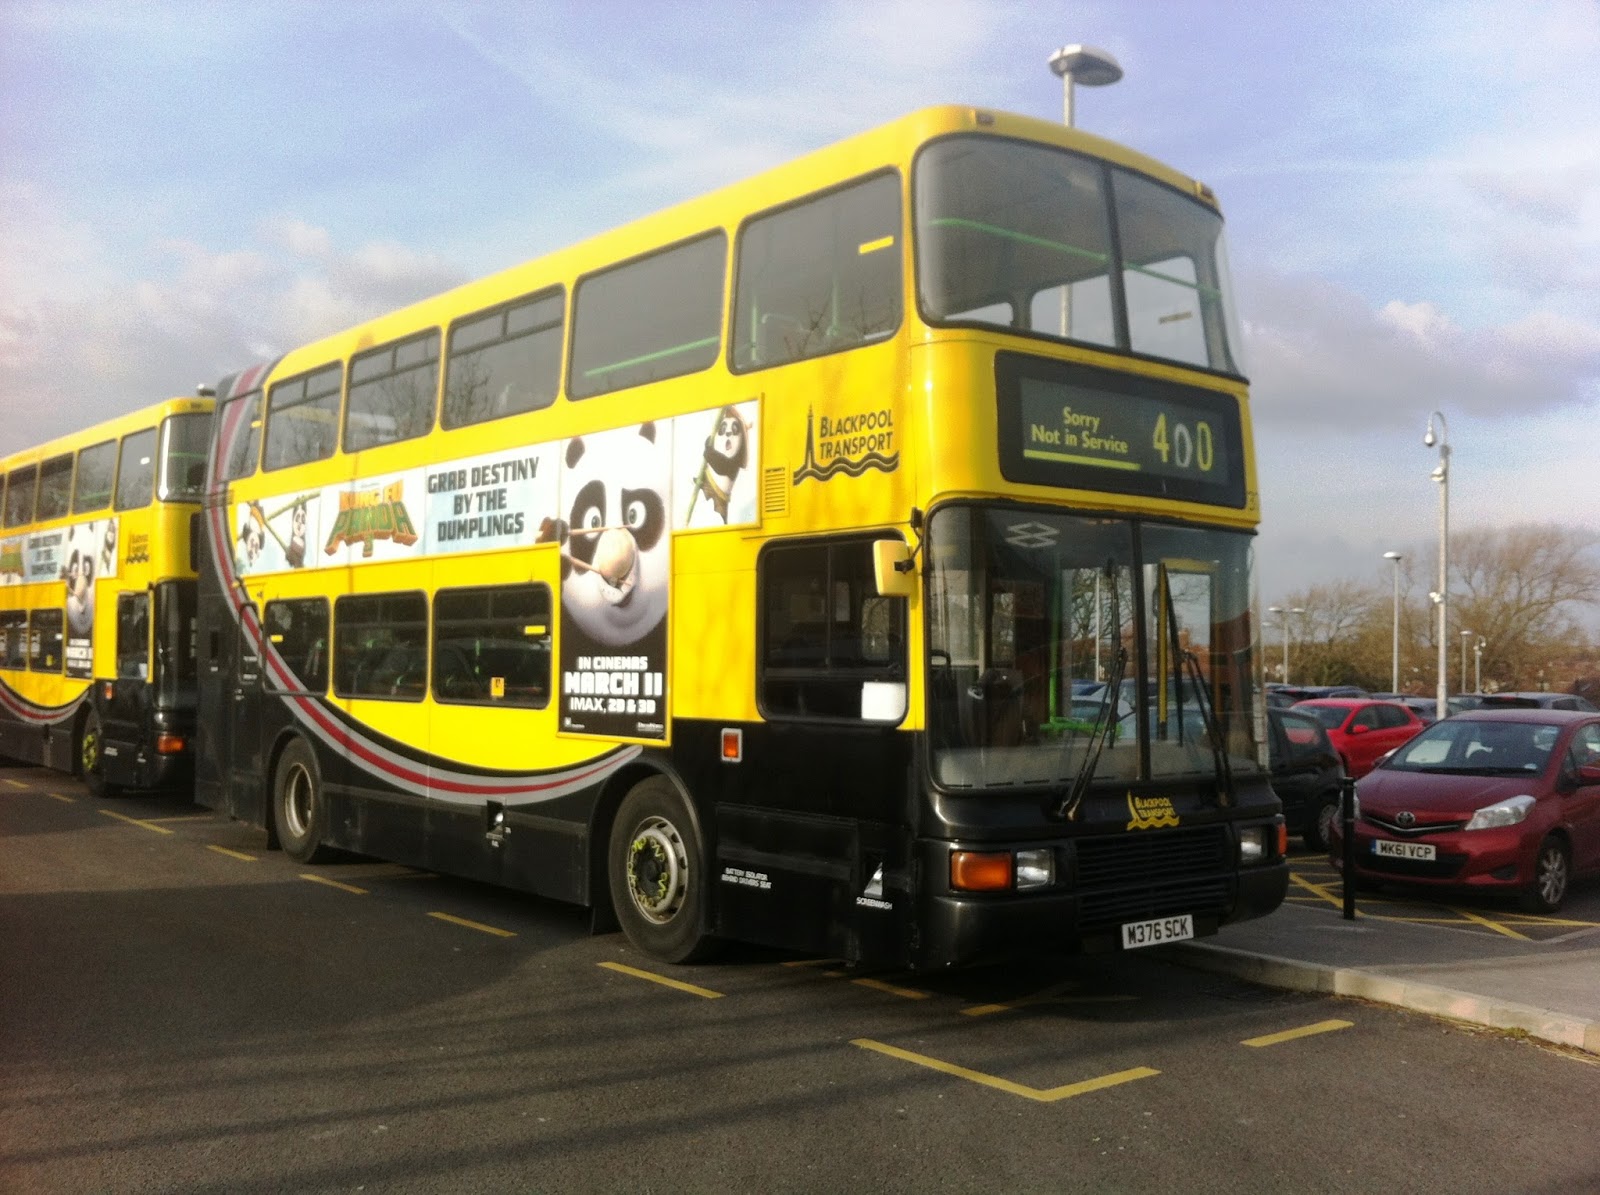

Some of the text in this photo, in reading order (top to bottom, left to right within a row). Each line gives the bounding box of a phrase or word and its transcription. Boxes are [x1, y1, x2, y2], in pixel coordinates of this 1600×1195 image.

[1063, 406, 1100, 433] Sorry
[819, 431, 893, 460] TRANSPORT
[1031, 424, 1128, 454] Not in Service
[1153, 412, 1213, 472] 400
[427, 456, 539, 494] GRAB DESTINY
[453, 488, 507, 515] BY THE
[437, 512, 525, 542] DUMPLINGS
[578, 656, 648, 670] IN CINEMAS
[564, 671, 639, 695] MARCH
[638, 699, 656, 713] 3D
[1409, 847, 1432, 858] VCP
[1127, 917, 1189, 945] M376 SCK
